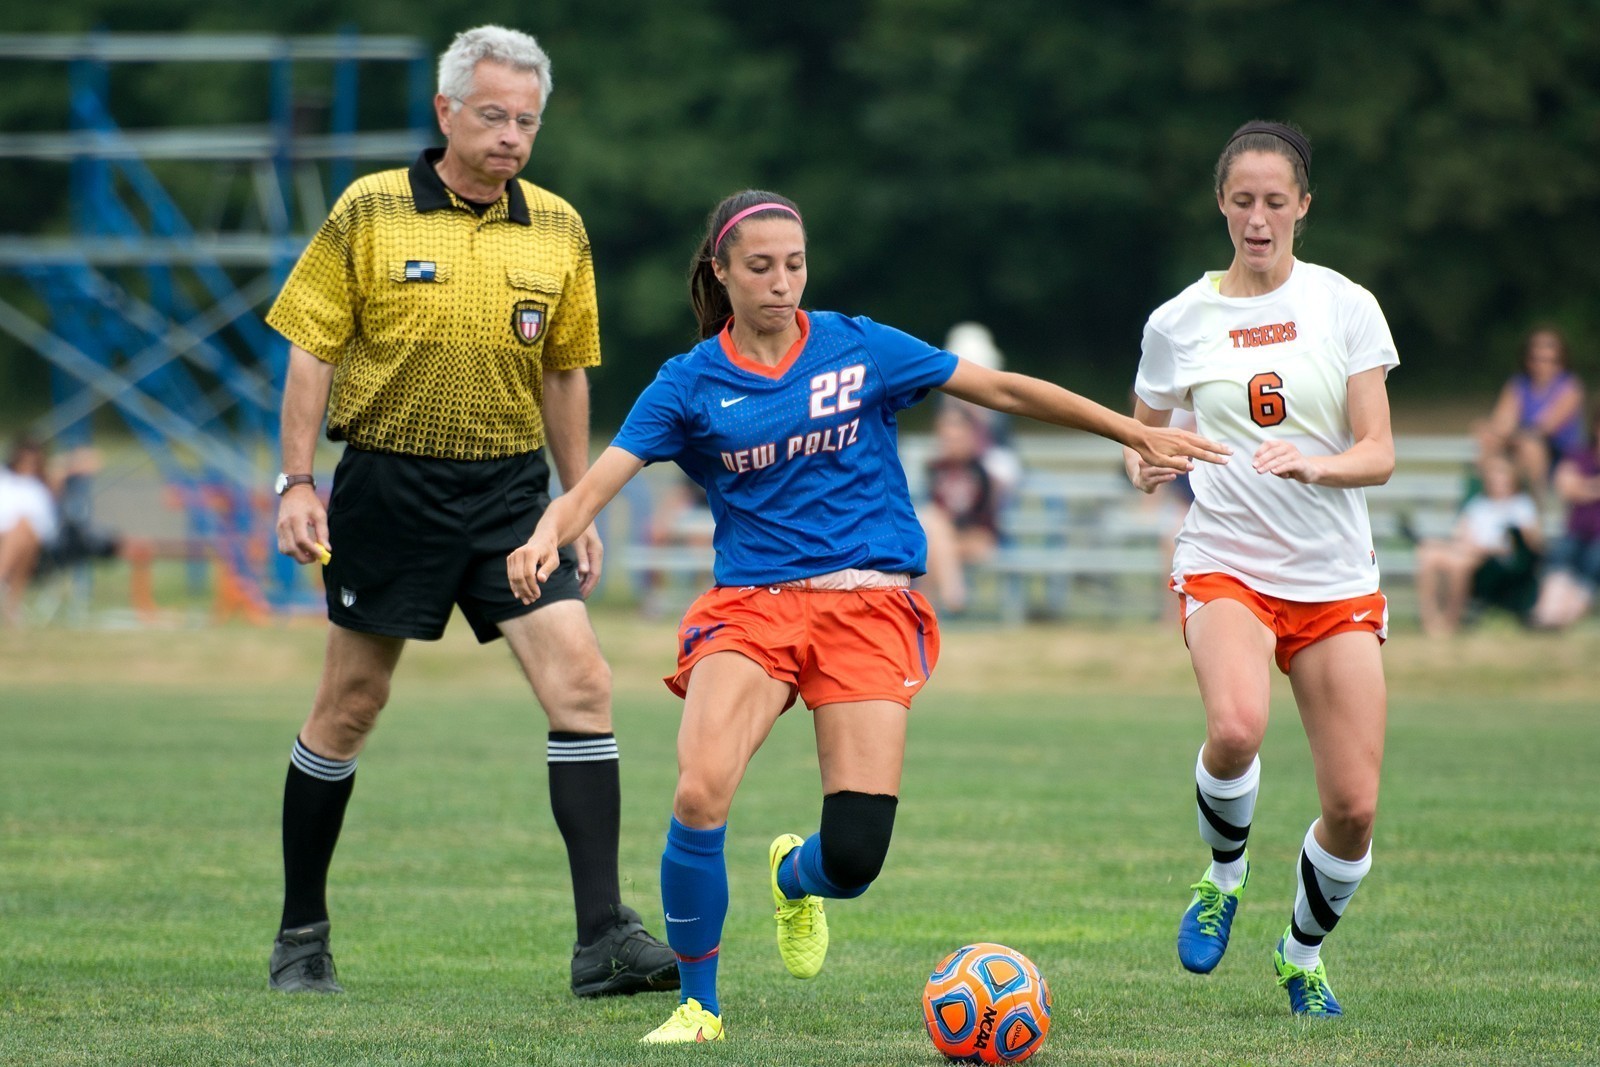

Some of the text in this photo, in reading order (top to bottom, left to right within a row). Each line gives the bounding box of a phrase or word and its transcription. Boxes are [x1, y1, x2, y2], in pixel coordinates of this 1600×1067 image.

[1229, 321, 1297, 348] TIGERS
[809, 364, 866, 419] 22
[1248, 371, 1287, 428] 6
[720, 418, 860, 474] NEW PALTZ
[973, 1005, 998, 1050] NCAA
